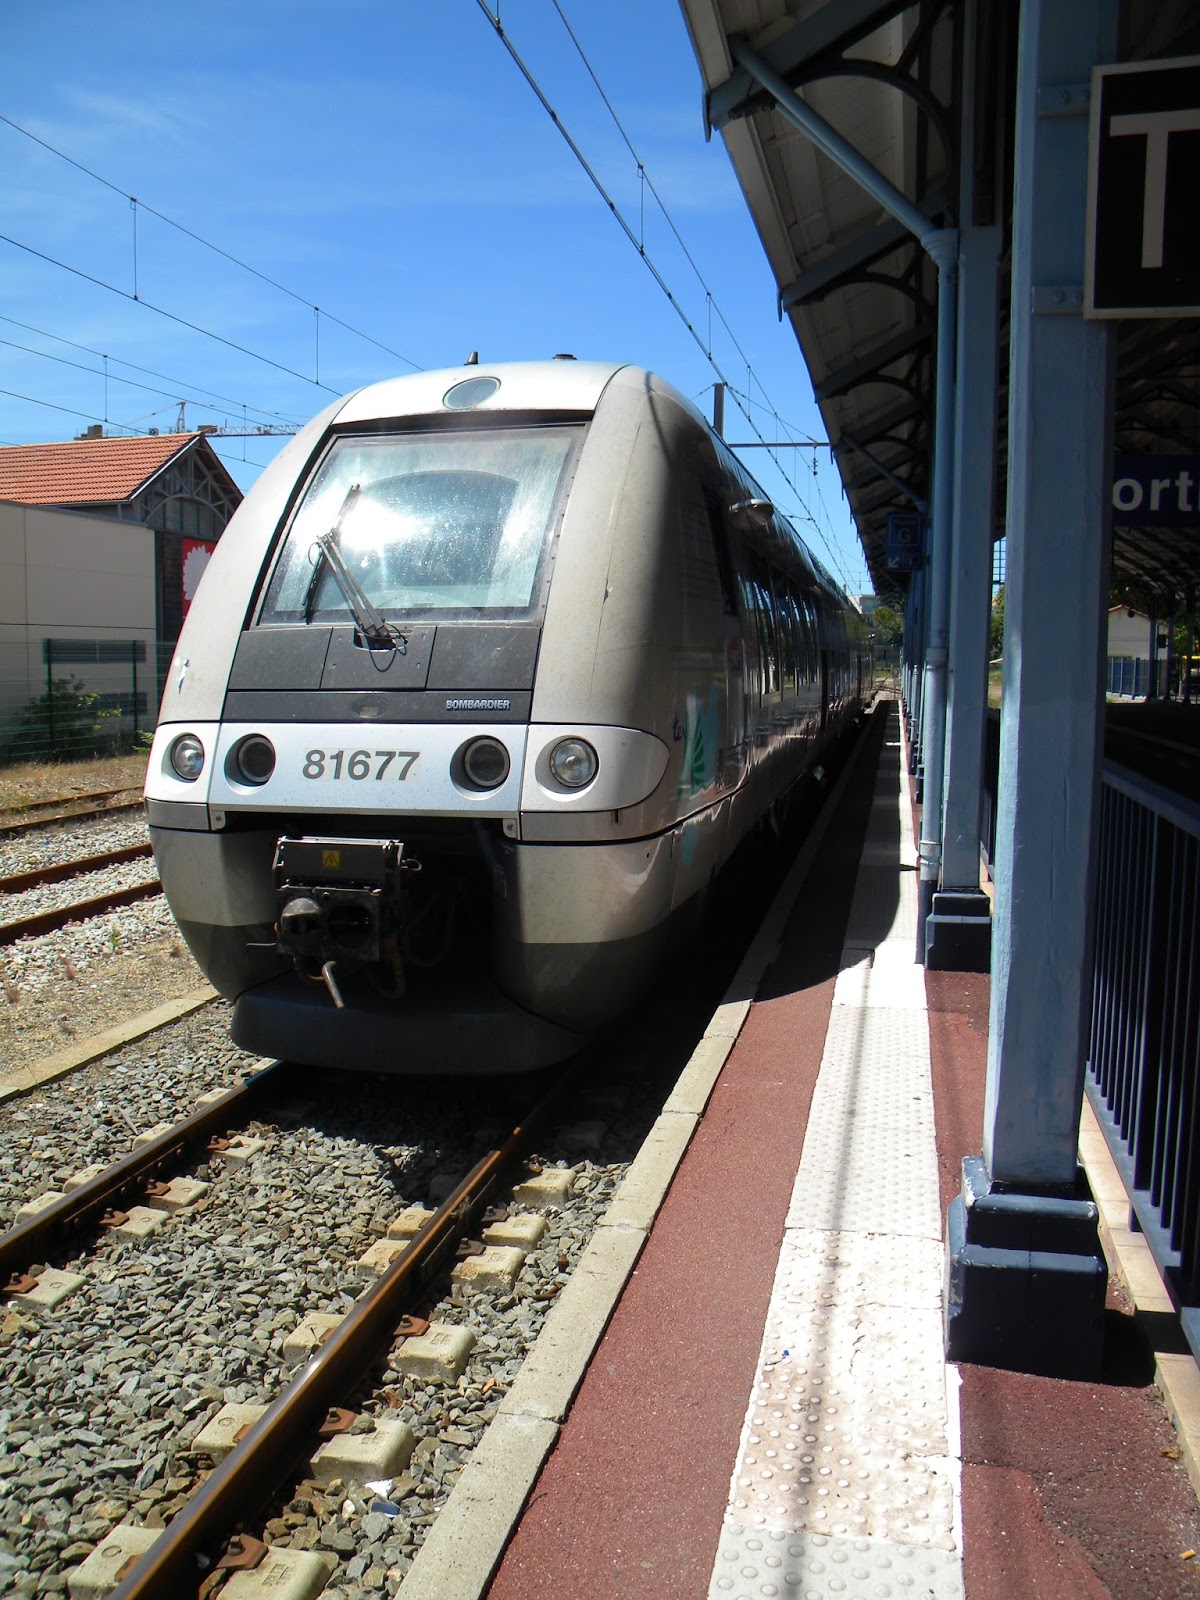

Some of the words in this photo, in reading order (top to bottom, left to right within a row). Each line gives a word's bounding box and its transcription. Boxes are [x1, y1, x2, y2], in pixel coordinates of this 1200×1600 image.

[1110, 108, 1200, 268] T
[1112, 470, 1200, 512] ort
[446, 699, 511, 711] BOMBARDIER
[302, 749, 421, 781] 81677
